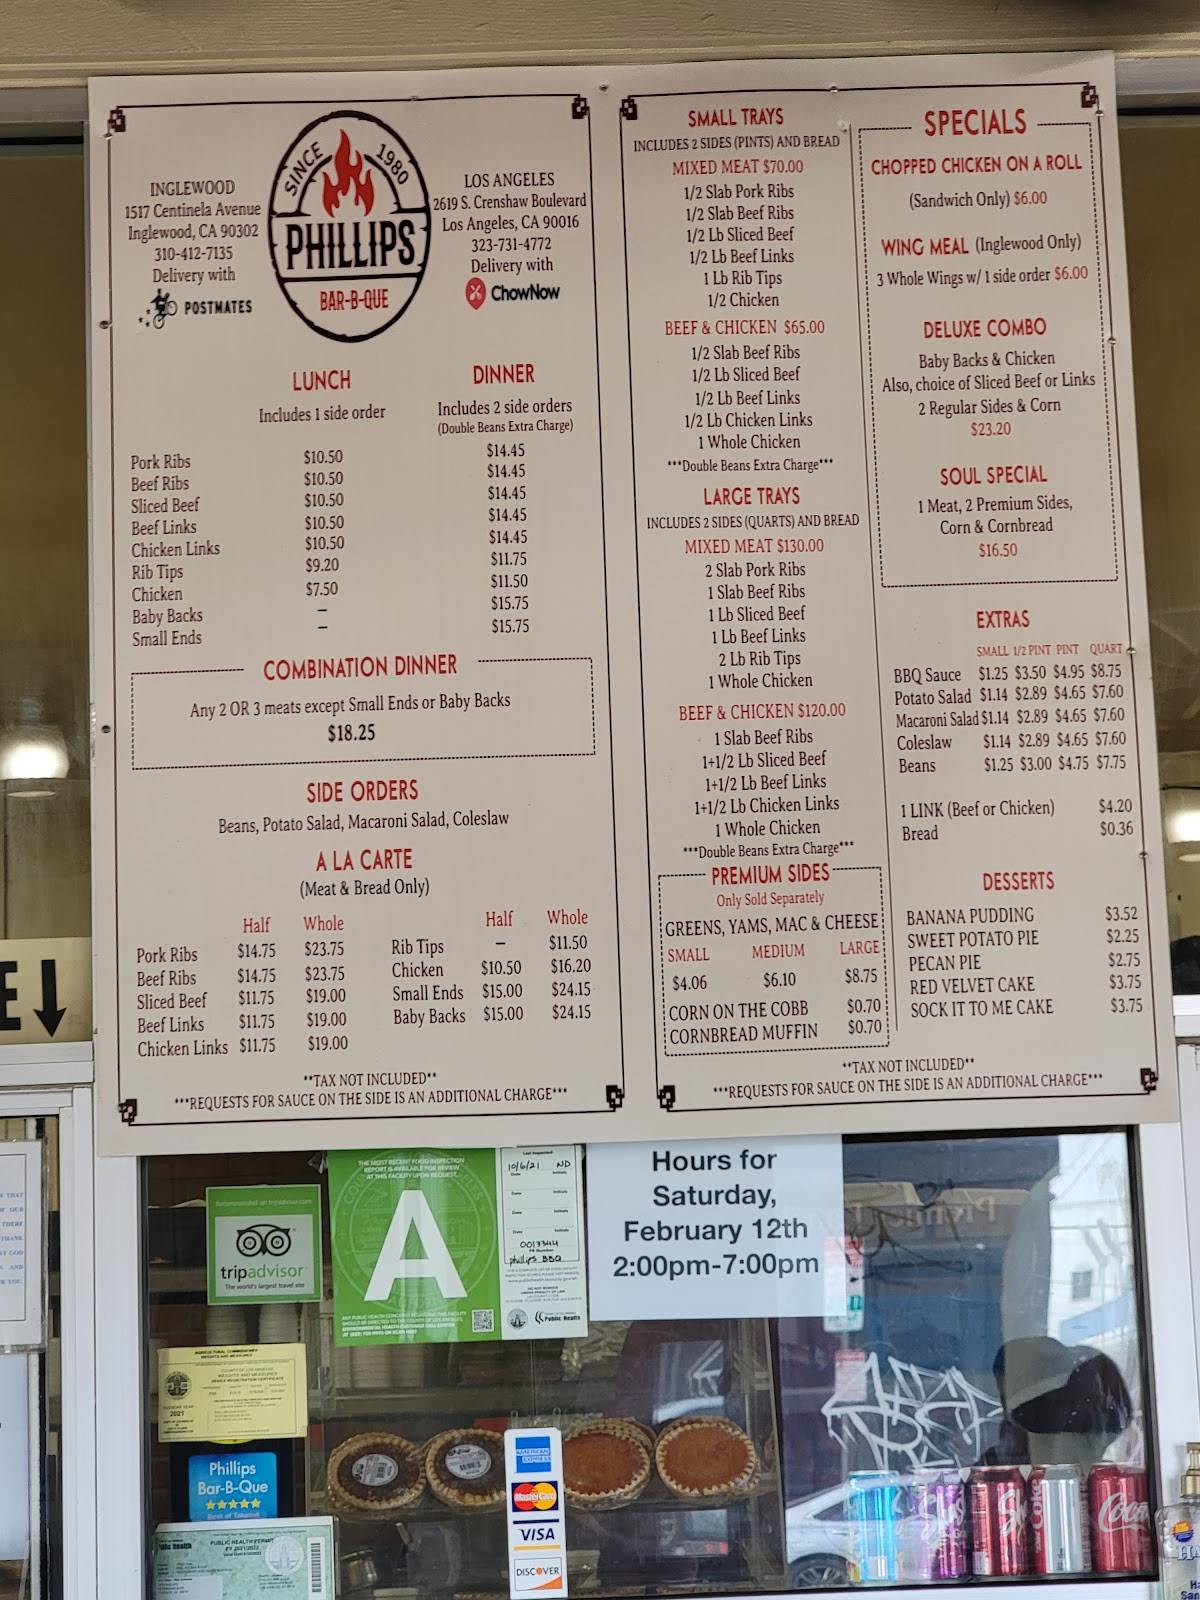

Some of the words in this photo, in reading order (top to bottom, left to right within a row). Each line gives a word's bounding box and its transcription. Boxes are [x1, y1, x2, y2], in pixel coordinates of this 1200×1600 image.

[688, 109, 737, 127] SMALL
[741, 107, 784, 125] TRAYS
[925, 108, 1026, 137] SPECIALS
[282, 140, 325, 198] SINCE
[375, 142, 410, 187] 1980
[673, 160, 717, 175] MIXED
[721, 159, 760, 174] MEAT
[763, 159, 804, 174] $70.00
[871, 158, 936, 175] CHOPPED
[941, 156, 1001, 174] CHICKEN
[1006, 156, 1028, 172] ON
[1033, 156, 1042, 171] A
[1046, 154, 1082, 170] ROLL
[150, 180, 235, 197] INGLEWOOD
[464, 173, 490, 188] LOS
[493, 172, 555, 187] ANGELES
[684, 185, 703, 201] 1/2
[706, 184, 732, 199] Slab
[735, 183, 764, 198] Pork
[768, 183, 794, 198] Ribs
[909, 191, 973, 211] (Sandwich
[976, 190, 1010, 210] Only)
[1014, 190, 1047, 206] $6.00
[125, 205, 150, 219] 1517
[153, 201, 212, 218] Centinela
[215, 201, 262, 217] Avenue
[433, 197, 458, 211] 2619
[461, 195, 471, 210] S.
[474, 193, 528, 209] Crenshaw
[526, 192, 587, 208] Boulevard
[286, 219, 415, 270] PHILLIPS
[472, 237, 551, 253] 323-731-4772
[154, 246, 233, 262] 310-412-7135
[320, 288, 389, 311] BAR-B-QUE
[491, 283, 560, 301] ChowNow
[185, 300, 252, 315] POSTMATES
[924, 320, 981, 339] DELUXE
[987, 317, 1047, 337] COMBO
[293, 370, 351, 391] LUNCH
[473, 363, 535, 384] DINNER
[438, 421, 475, 436] (Double
[477, 421, 506, 433] Beans
[508, 420, 534, 432] Extra
[536, 418, 573, 434] Charge)
[971, 421, 1011, 437] $23.20
[304, 449, 343, 465] $10.50
[487, 443, 525, 458] $14.45
[131, 454, 160, 470] Pork
[164, 453, 191, 469] Ribs
[704, 487, 752, 505] LARGE
[757, 486, 800, 505] TRAYS
[305, 536, 345, 551] $10.50
[489, 529, 527, 544] $14.45
[131, 541, 182, 558] Chicken
[186, 540, 220, 556] Links
[976, 610, 1030, 629] EXTRAS
[976, 645, 1010, 657] SMALL
[1013, 645, 1027, 656] 1/2
[1028, 644, 1052, 656] PINT
[1056, 644, 1079, 655] PINT
[1090, 643, 1123, 656] QUART
[264, 656, 387, 681] COMBINATION
[395, 654, 457, 676] DINNER
[894, 668, 923, 685] BBQ
[925, 667, 961, 682] Sauce
[979, 666, 1008, 681] $1.25
[1015, 665, 1046, 680] $3.50
[1053, 664, 1085, 679] $4.95
[1091, 663, 1122, 678] $8.75
[328, 723, 375, 742] $18.25
[307, 781, 343, 803] SIDE
[351, 779, 418, 802] ORDERS
[316, 851, 327, 871] A
[333, 850, 354, 871] LA
[360, 848, 412, 870] CARTE
[712, 865, 782, 885] PREMIUM
[788, 863, 830, 883] SIDES
[983, 871, 1055, 891] DESSERTS
[716, 893, 742, 910] Only
[744, 892, 768, 906] Sold
[770, 890, 825, 908] Separately
[906, 909, 966, 926] BANANA
[970, 907, 1034, 924] PUDDING
[1105, 906, 1138, 921] $3.52
[243, 916, 271, 933] Half
[303, 914, 344, 931] Whole
[137, 970, 166, 987] Beef
[169, 969, 196, 986] Ribs
[237, 968, 276, 984] $14.75
[305, 966, 345, 982] $23.75
[394, 1008, 425, 1028] Baby
[429, 1007, 466, 1024] Backs
[484, 1006, 523, 1022] $15.00
[552, 1004, 591, 1020] $24.15
[878, 1060, 903, 1073] NOT
[507, 1161, 540, 1172] 10/6/21
[653, 1150, 731, 1172] Hours
[739, 1149, 777, 1170] for
[653, 1184, 776, 1209] Saturday,
[624, 1220, 742, 1244] February
[752, 1218, 807, 1239] 12th
[363, 1189, 469, 1302] A
[220, 1264, 305, 1283] tripadvisor
[613, 1253, 818, 1281] 2:00pm-7:00pm
[208, 1462, 257, 1479] Phillips
[197, 1479, 269, 1496] Bar-B-Que
[520, 1528, 556, 1541] VISA
[516, 1566, 560, 1577] DISCOVER
